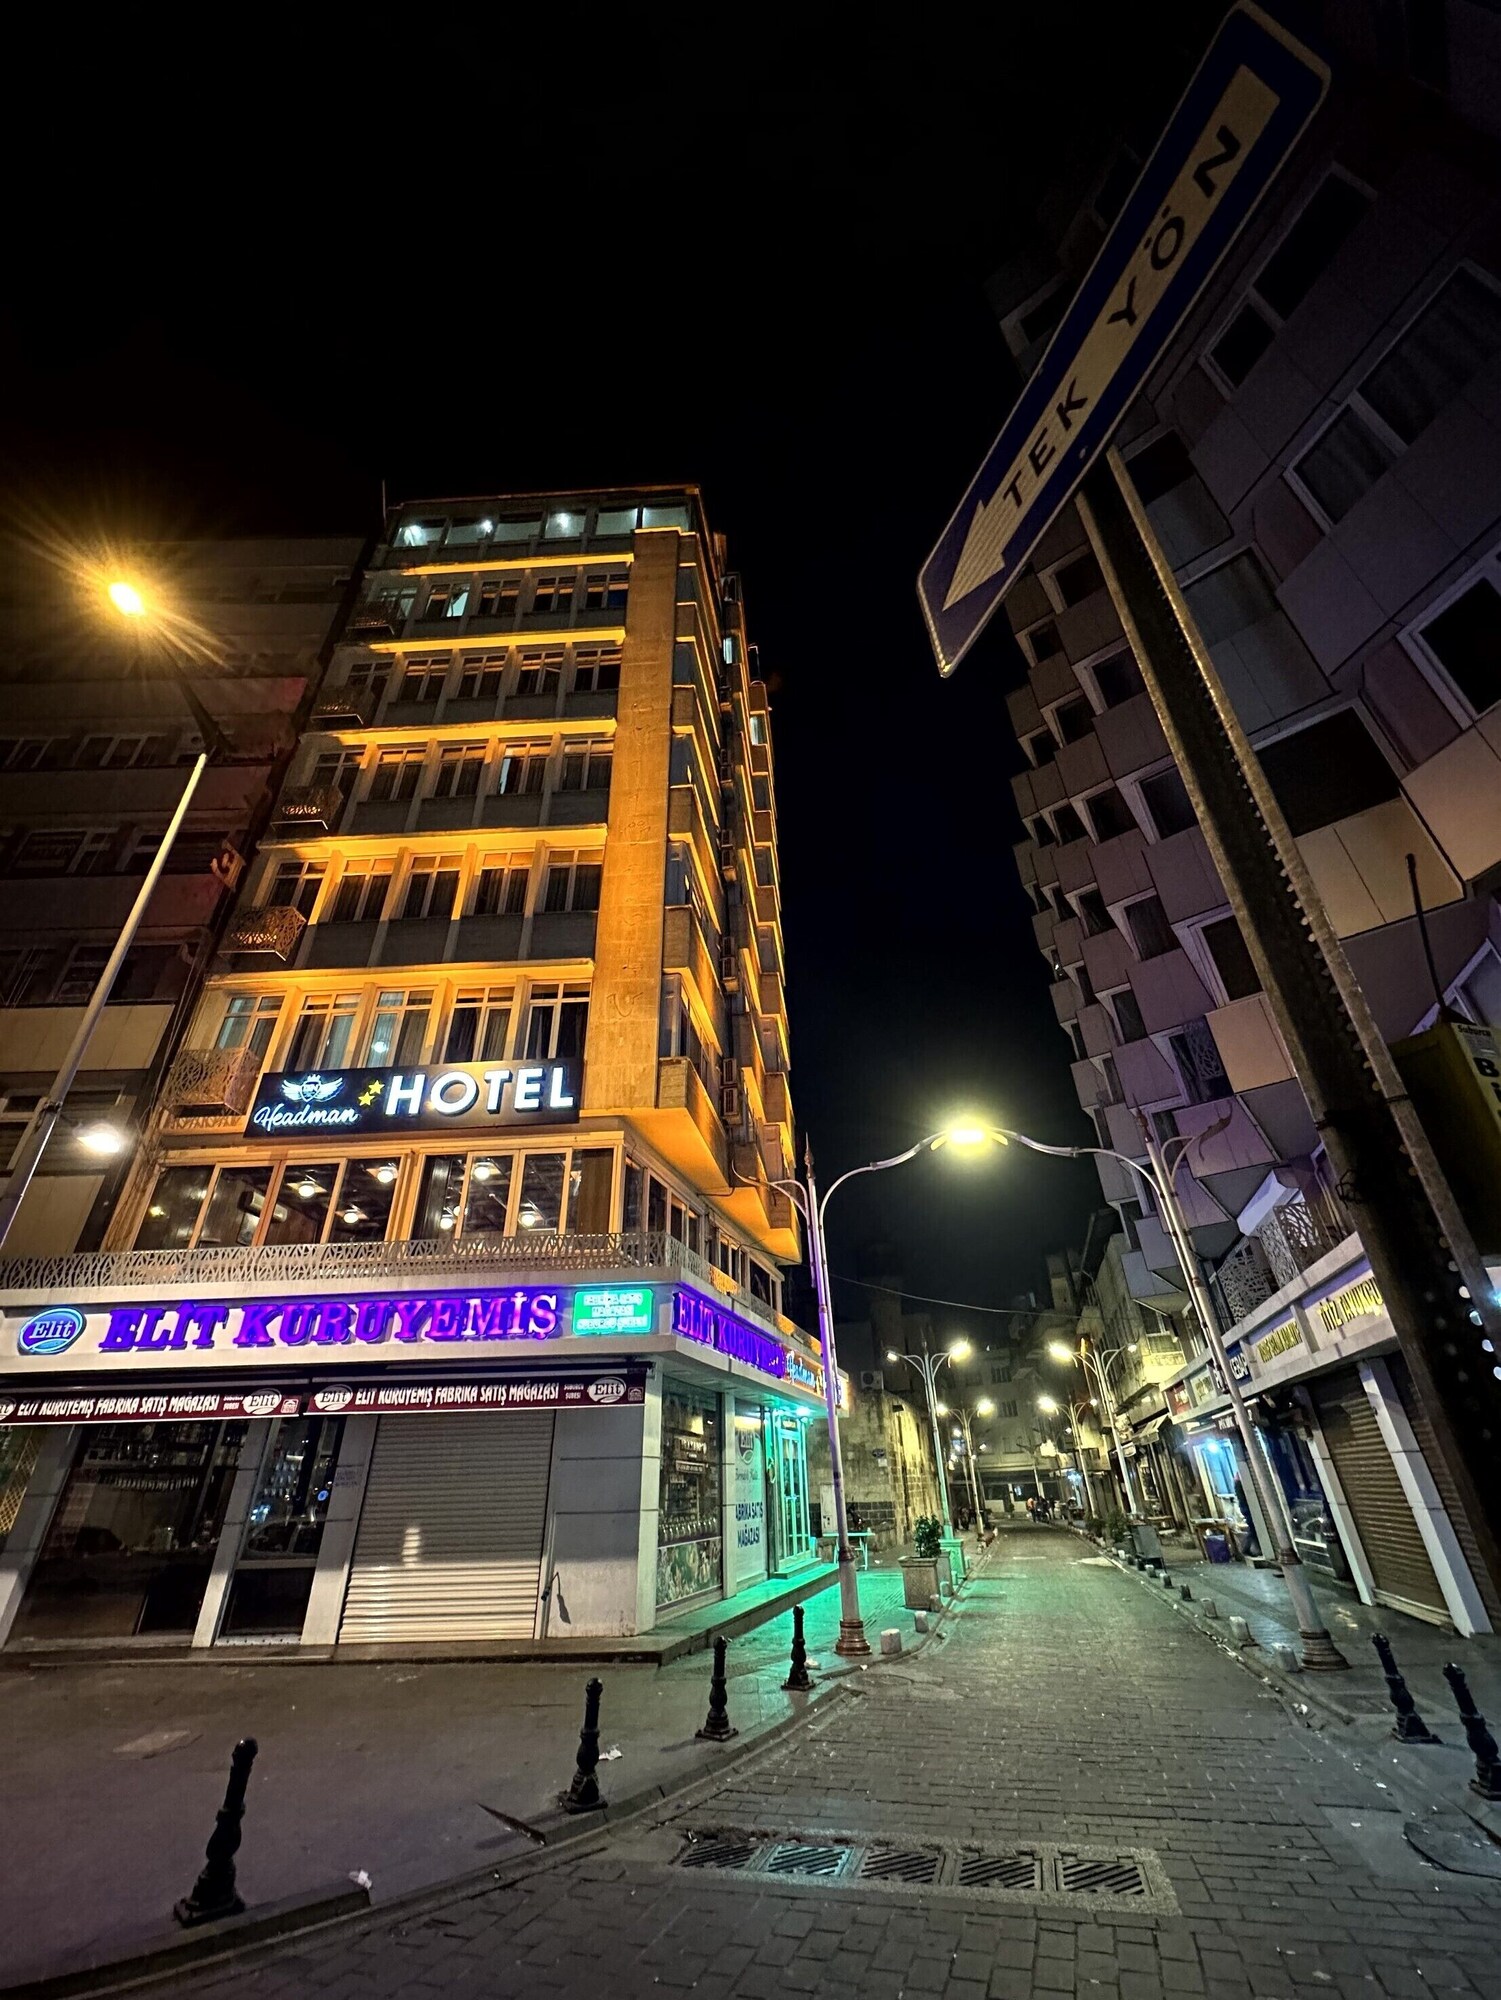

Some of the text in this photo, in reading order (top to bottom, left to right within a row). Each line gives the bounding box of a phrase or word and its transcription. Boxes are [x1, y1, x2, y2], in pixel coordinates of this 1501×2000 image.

[1005, 124, 1241, 508] TEK YÖN
[384, 1067, 574, 1116] HOTEL
[254, 1104, 359, 1132] Headman
[29, 1320, 73, 1340] Elit
[98, 1292, 558, 1350] ELİT KURUYEMİŞ
[479, 1385, 507, 1406] SATIŞ
[508, 1380, 560, 1402] MAĞAZASI
[594, 1383, 621, 1396] Elit
[140, 1396, 168, 1417] SATIŞ
[167, 1391, 220, 1413] MAĞAZASI
